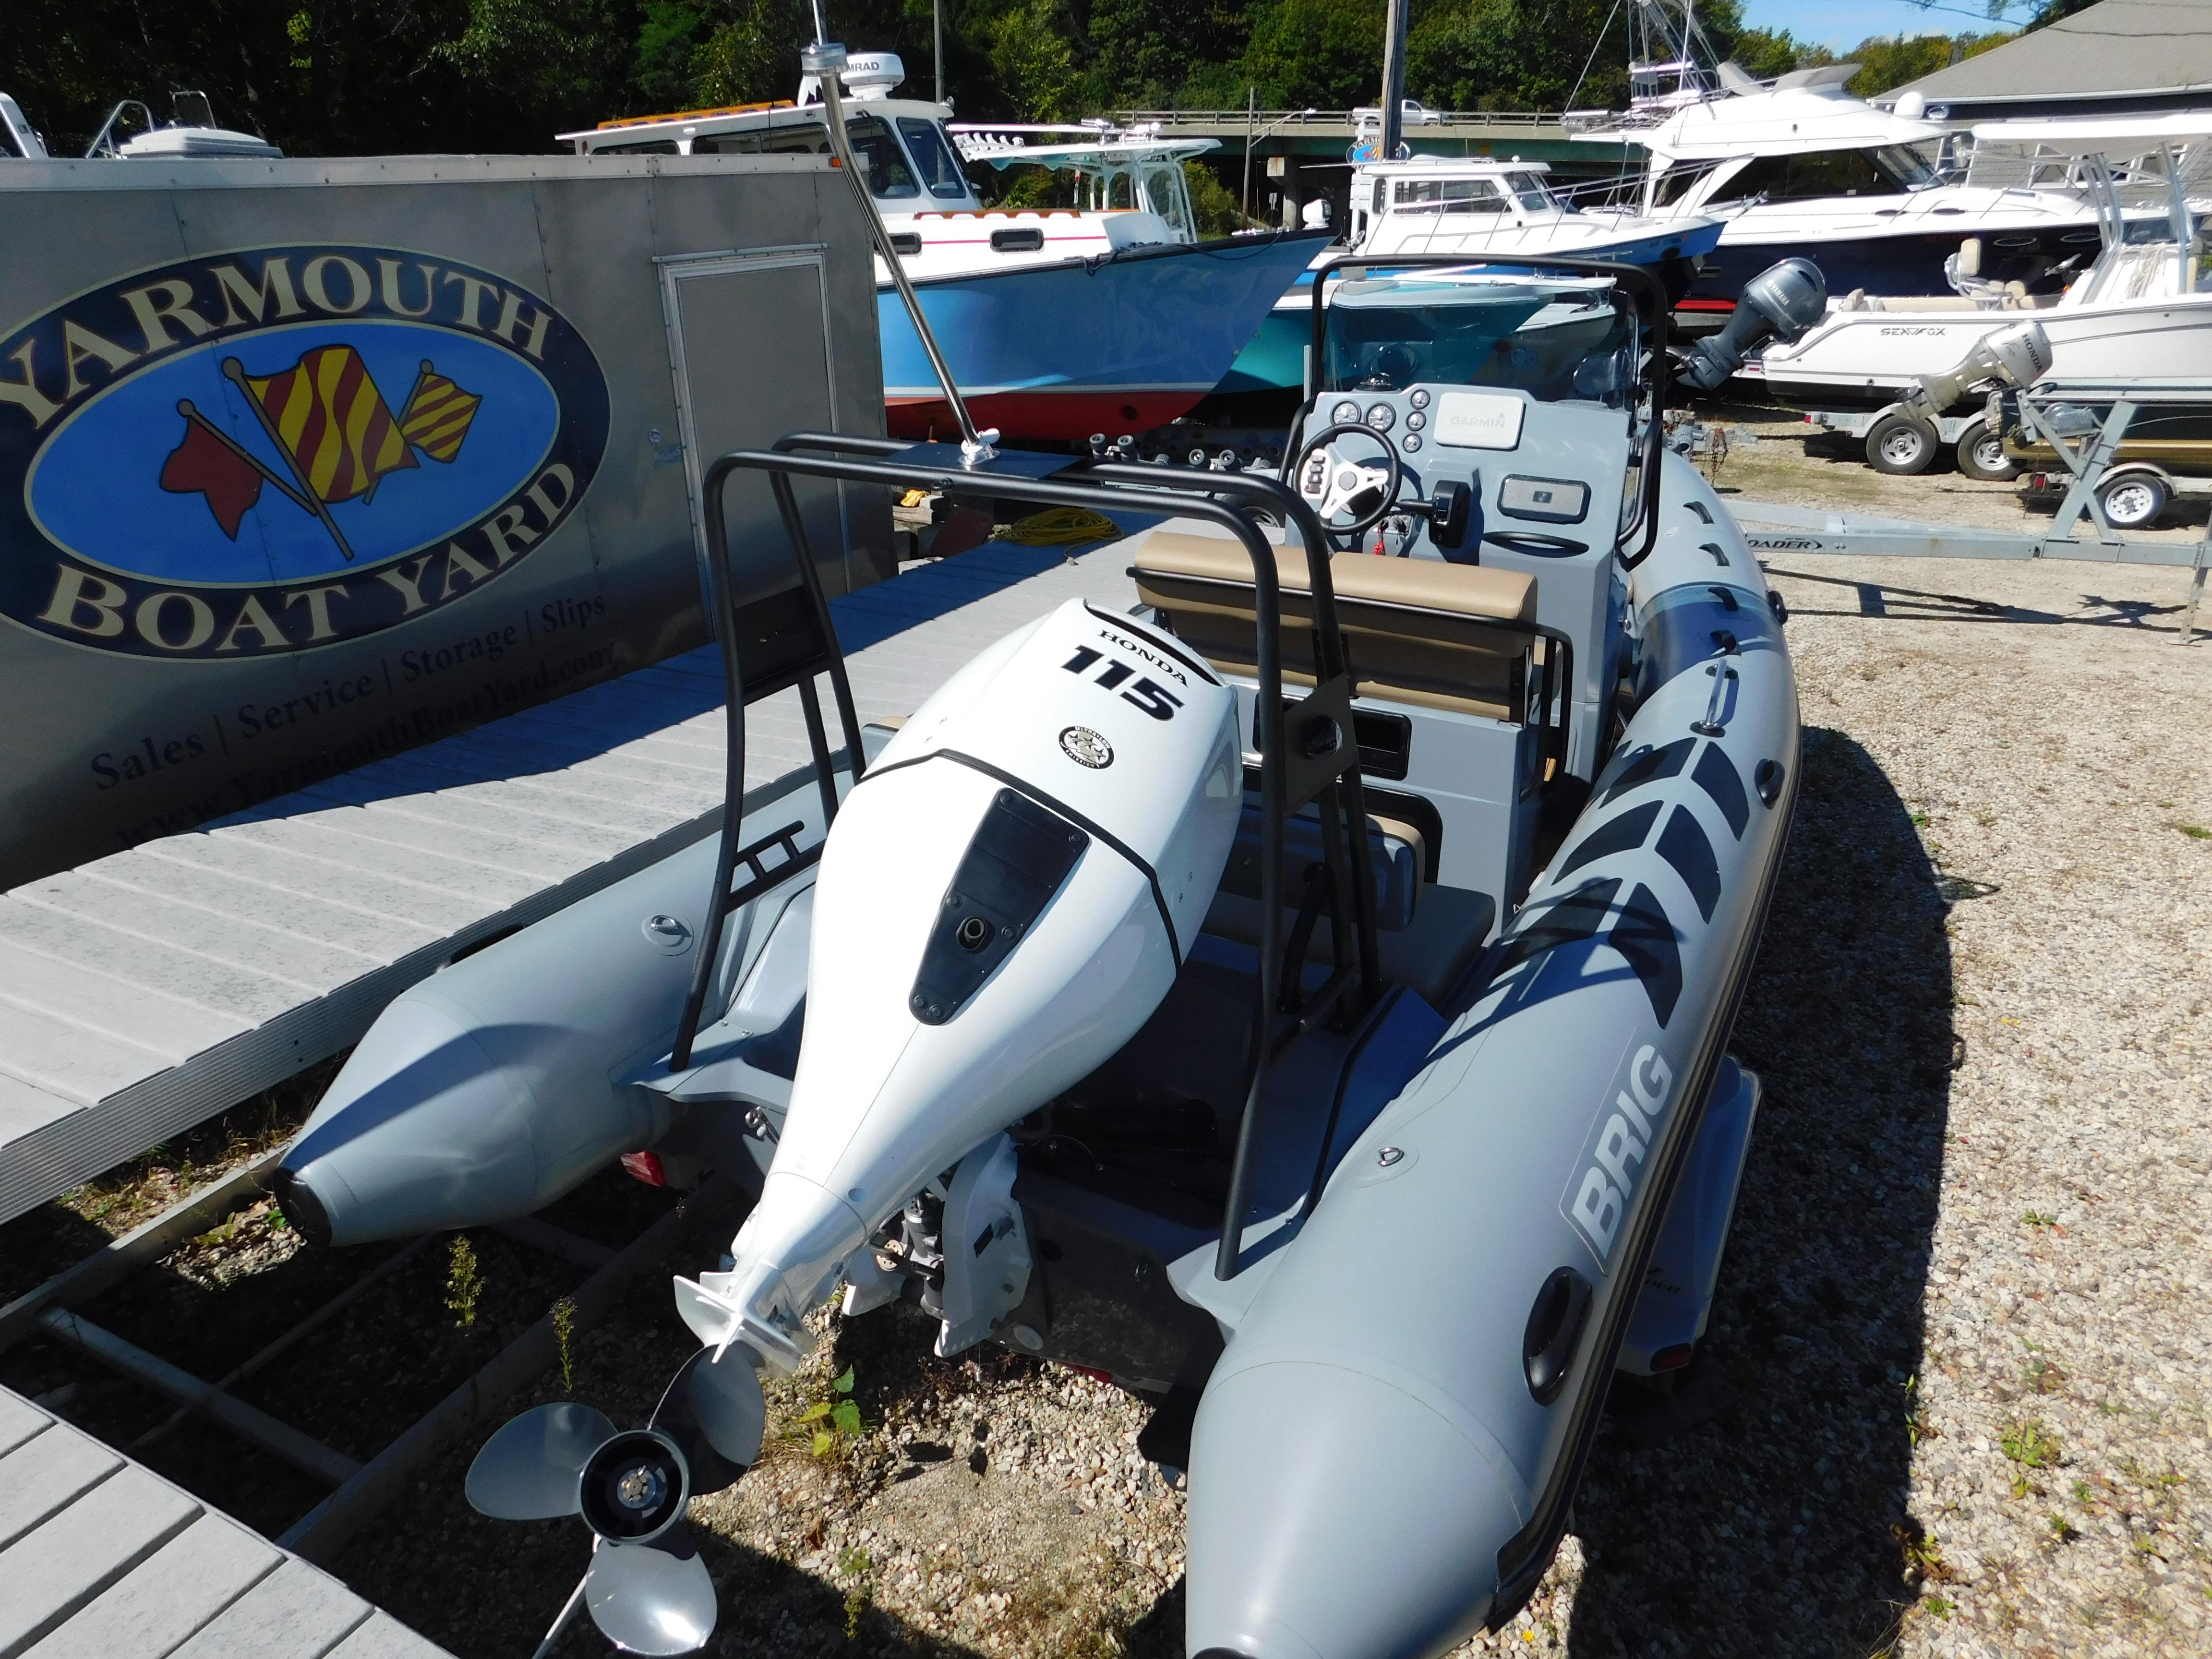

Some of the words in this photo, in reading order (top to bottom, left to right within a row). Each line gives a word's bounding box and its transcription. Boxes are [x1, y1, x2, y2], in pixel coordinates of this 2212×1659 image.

[846, 62, 879, 72] MRAD
[1353, 137, 1380, 149] YARM
[1770, 284, 1790, 306] YAMAHA
[0, 254, 555, 432] YARMOUTH
[2021, 333, 2042, 372] HONDA
[1451, 416, 1505, 428] GARMIN
[39, 564, 349, 652] BOAT
[375, 462, 576, 615] YARD
[1747, 540, 1811, 549] OADER
[1060, 644, 1185, 721] 115
[1097, 629, 1189, 688] HONDA
[91, 736, 204, 790] Sales
[237, 673, 374, 739] Service
[402, 625, 517, 682] Storage
[541, 595, 604, 633] Slips
[1571, 1045, 1673, 1259] BRIG
